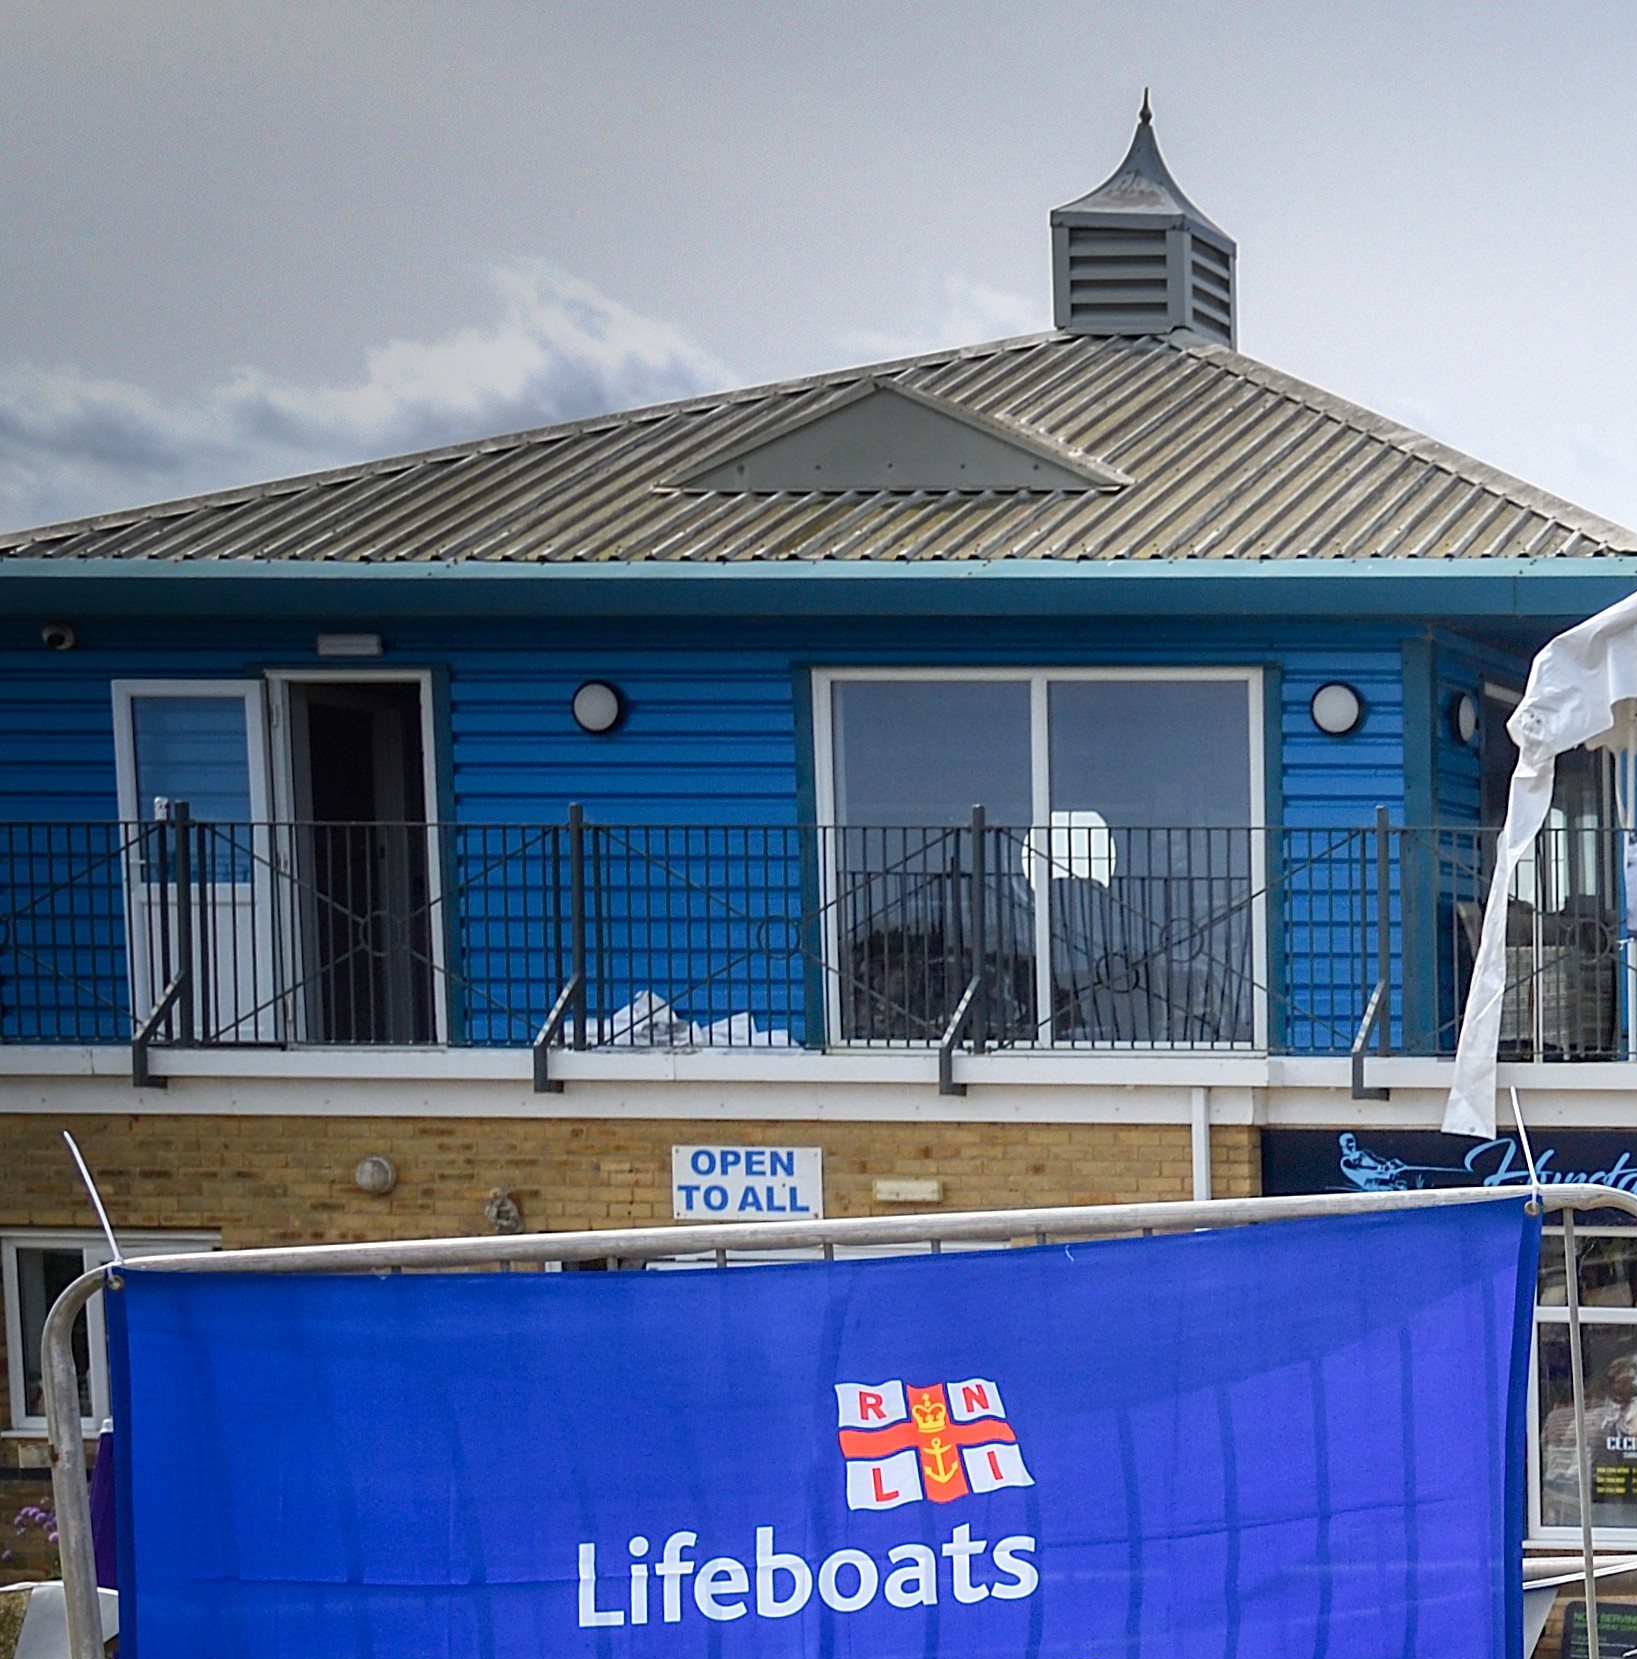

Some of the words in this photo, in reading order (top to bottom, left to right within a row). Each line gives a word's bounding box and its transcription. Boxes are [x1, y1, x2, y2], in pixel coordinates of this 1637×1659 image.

[691, 1150, 794, 1176] OPEN
[678, 1185, 729, 1211] TO
[738, 1186, 810, 1212] ALL
[578, 1523, 1039, 1627] Lifeboats
